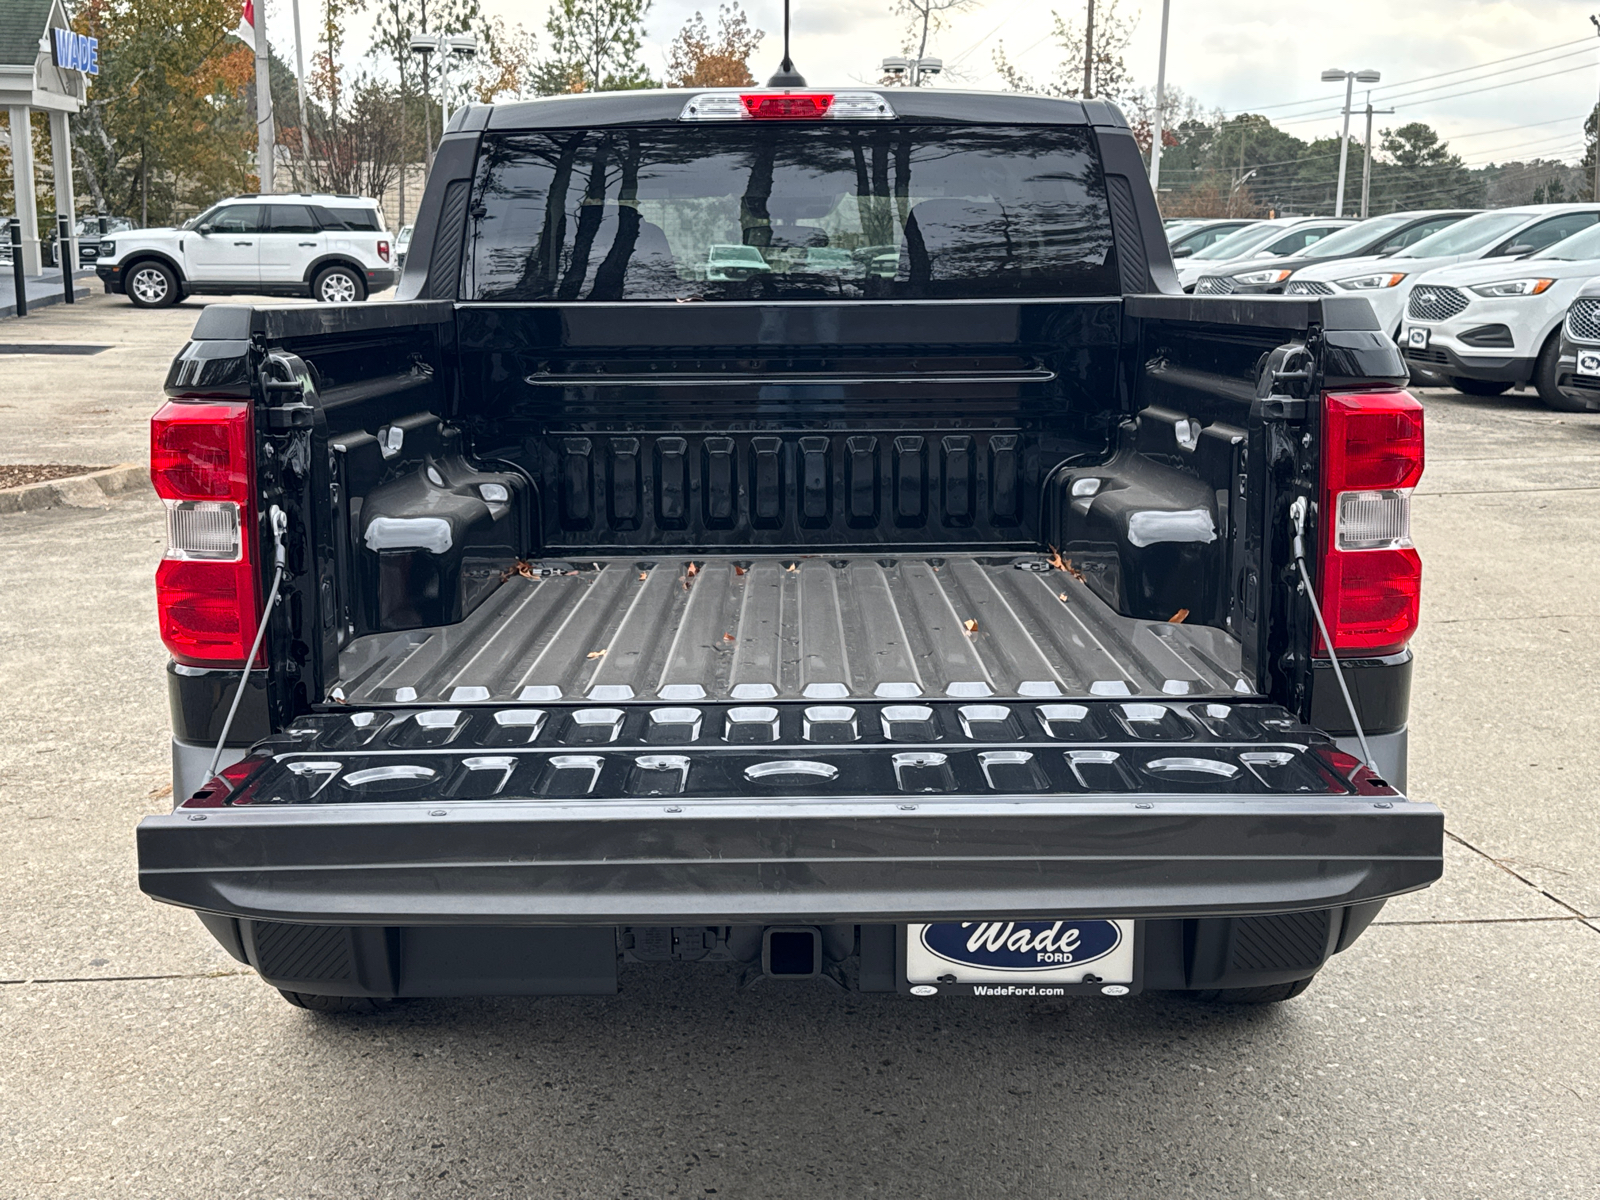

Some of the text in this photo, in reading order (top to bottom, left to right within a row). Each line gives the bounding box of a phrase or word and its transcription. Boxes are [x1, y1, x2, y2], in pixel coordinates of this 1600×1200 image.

[54, 26, 99, 75] WADE
[962, 921, 1081, 953] Wade
[1037, 953, 1073, 963] FORD
[974, 986, 1064, 996] WadeFord.com
